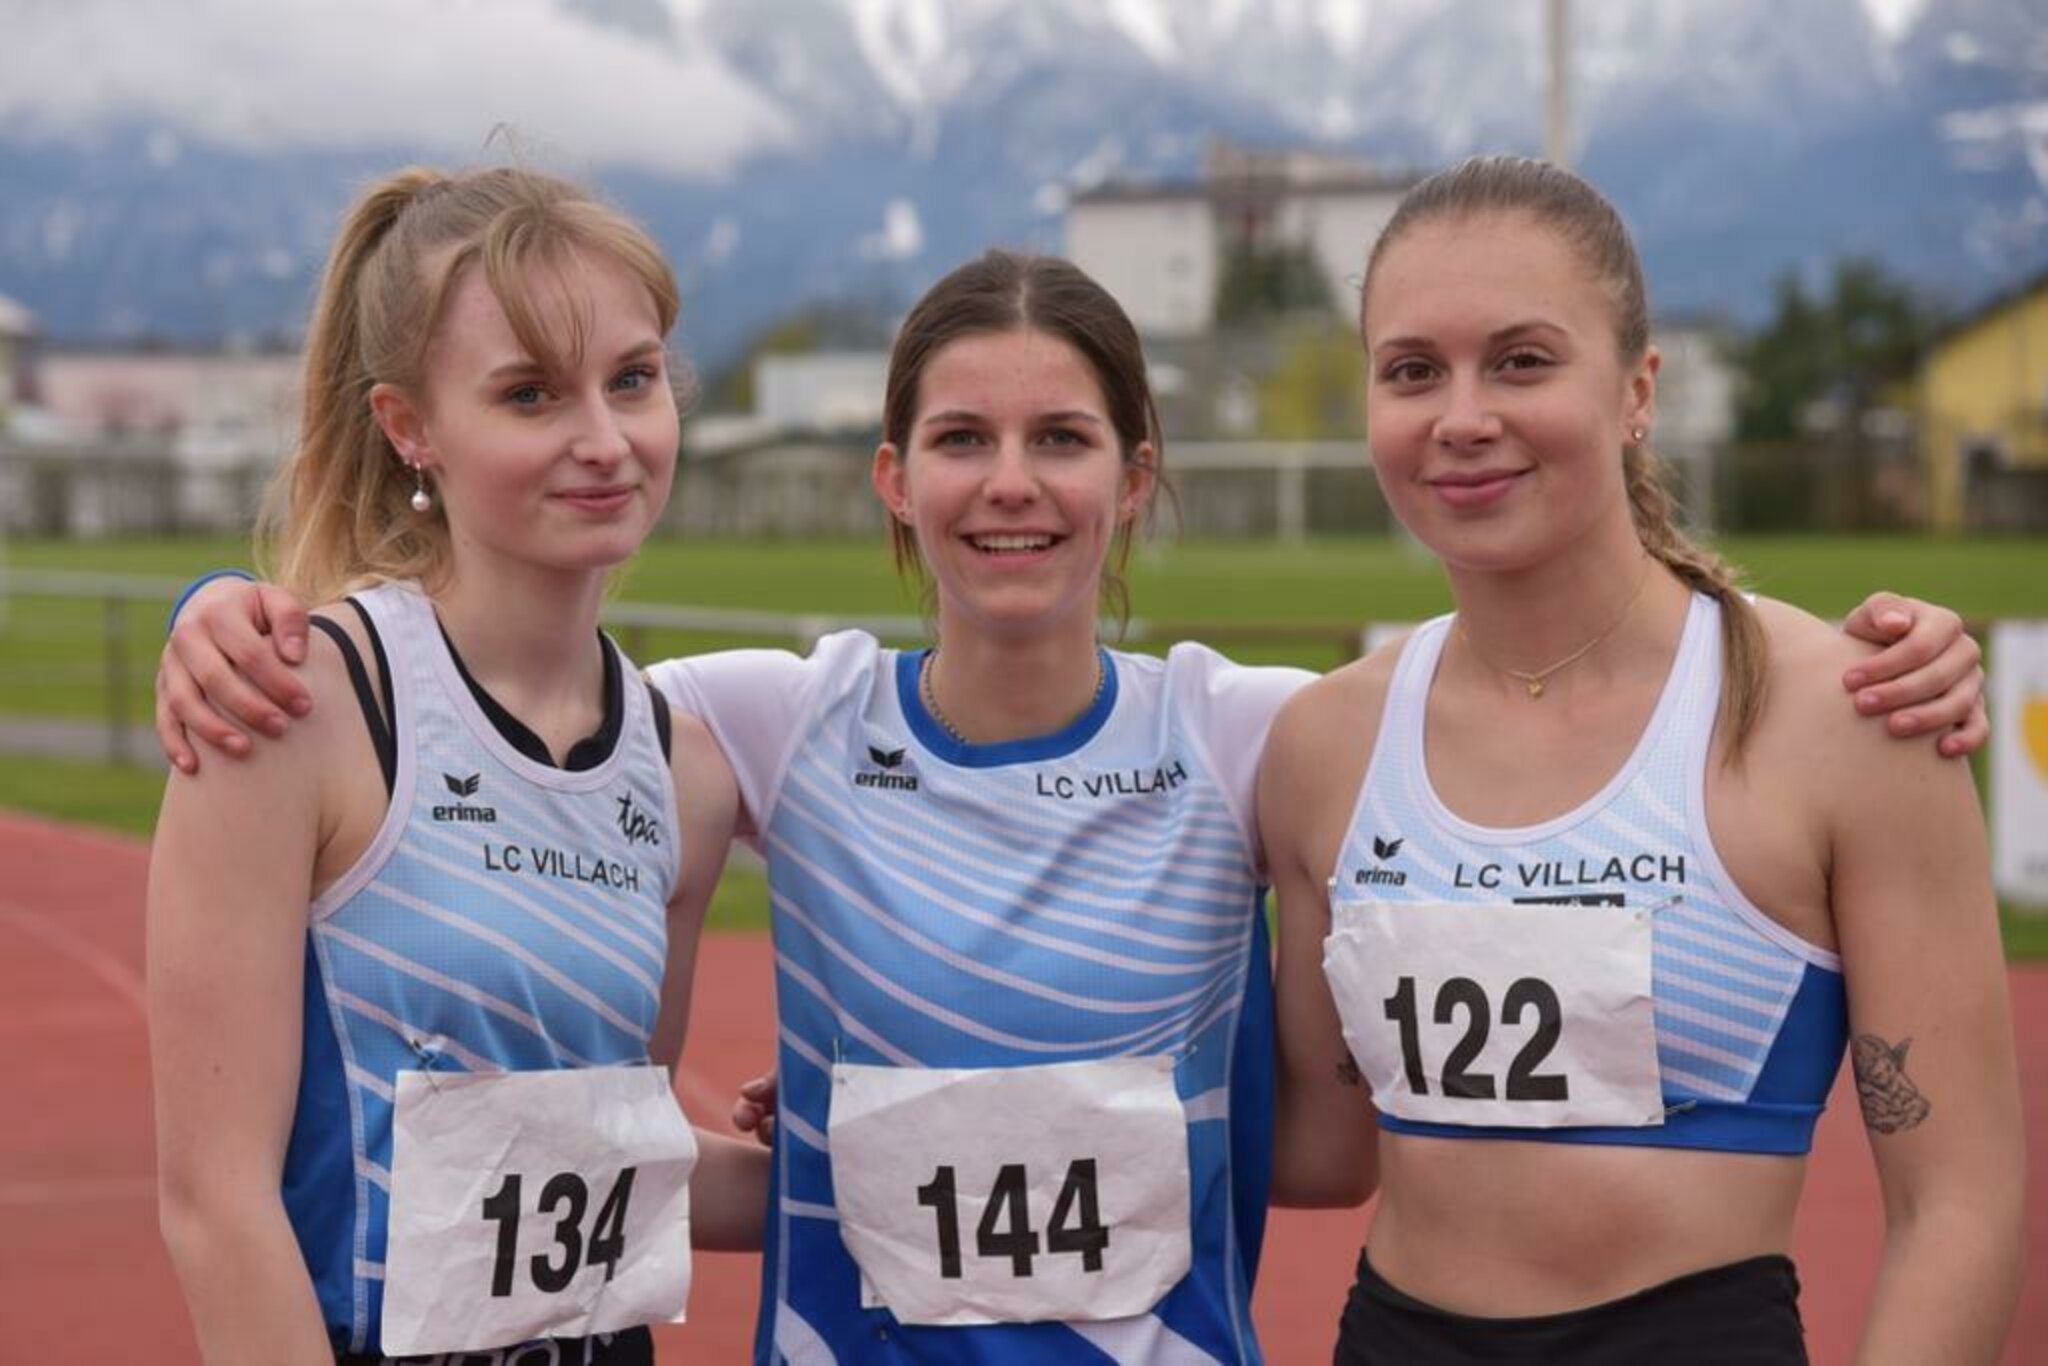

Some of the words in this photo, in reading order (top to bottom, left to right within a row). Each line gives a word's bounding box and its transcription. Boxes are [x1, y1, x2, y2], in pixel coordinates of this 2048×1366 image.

[855, 769, 918, 791] erima
[1036, 773, 1074, 799] LC
[432, 802, 497, 823] erima
[484, 844, 521, 871] LC
[531, 848, 640, 892] VILLACH
[1355, 866, 1407, 887] erima
[1453, 863, 1502, 889] LC
[1517, 855, 1686, 888] VILLACH
[1383, 976, 1568, 1101] 122
[482, 1166, 637, 1297] 134
[917, 1158, 1109, 1279] 144
